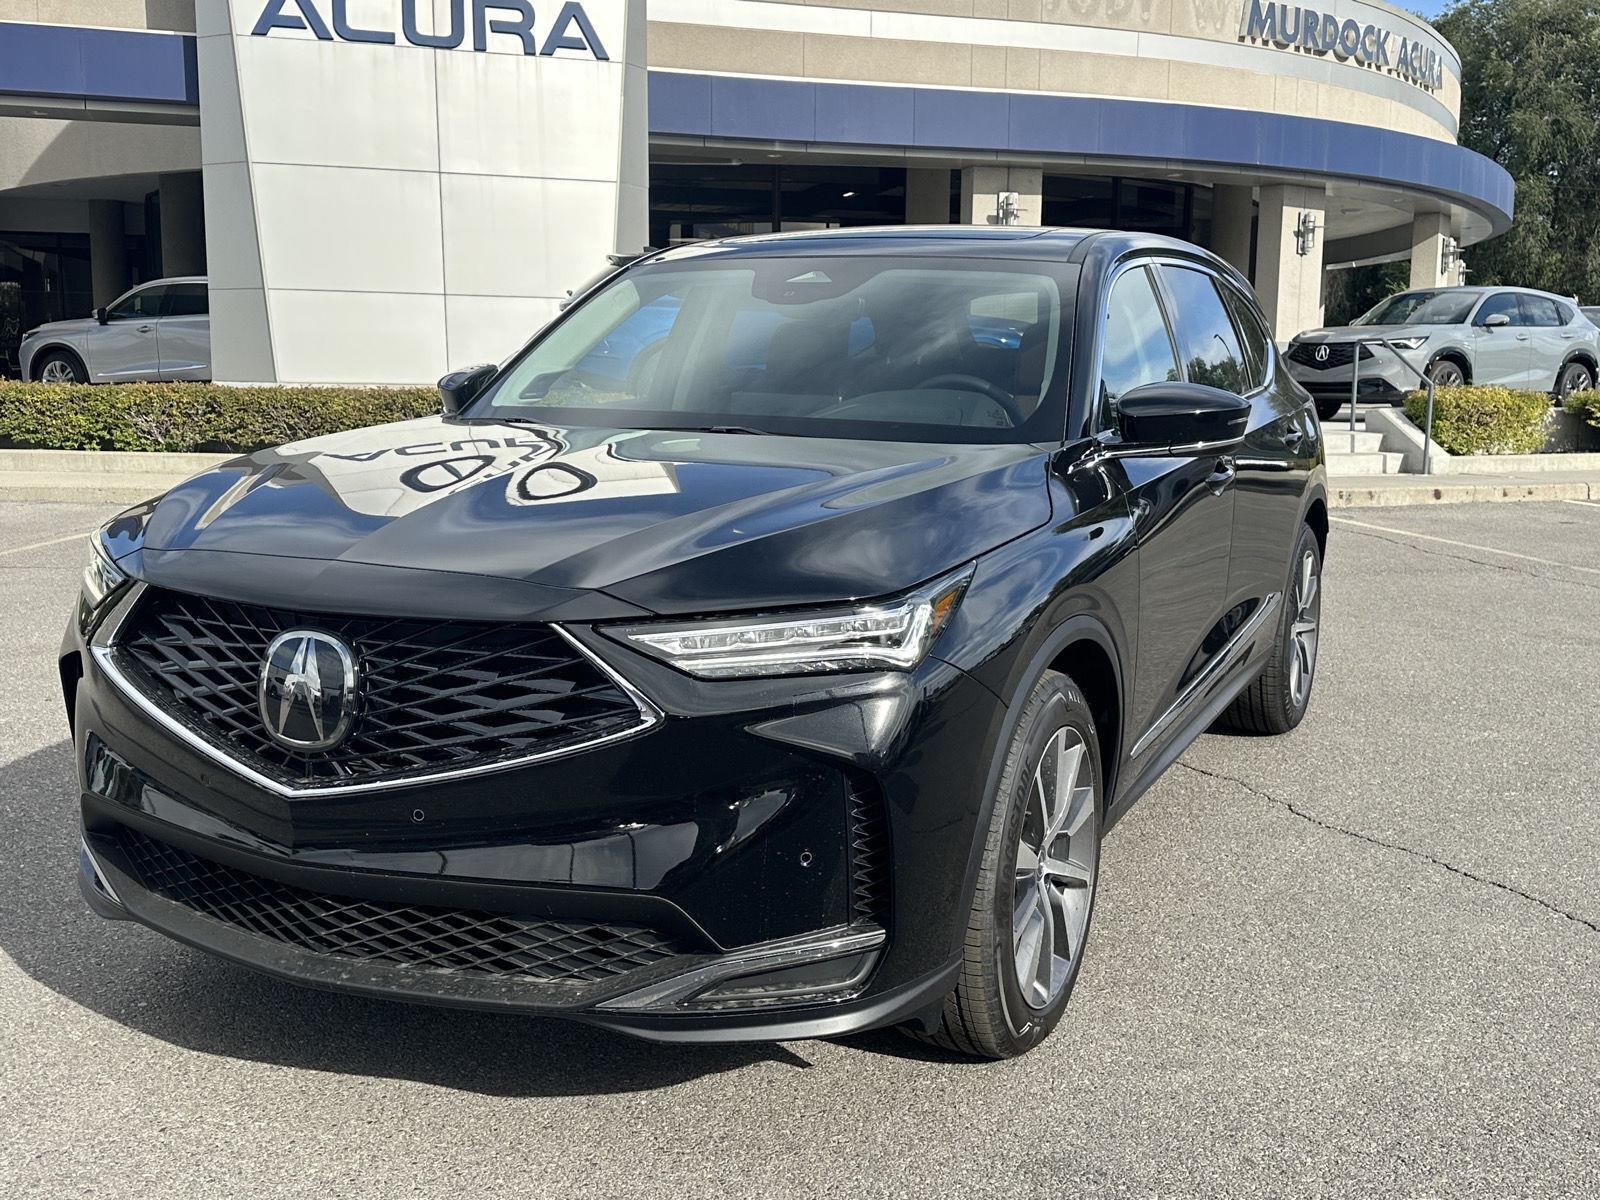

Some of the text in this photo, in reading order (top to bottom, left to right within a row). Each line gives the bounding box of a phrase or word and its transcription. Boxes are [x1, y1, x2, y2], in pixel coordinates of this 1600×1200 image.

[251, 0, 609, 60] ACURA
[1244, 0, 1391, 66] MURDOCK
[1396, 36, 1442, 89] ACURA
